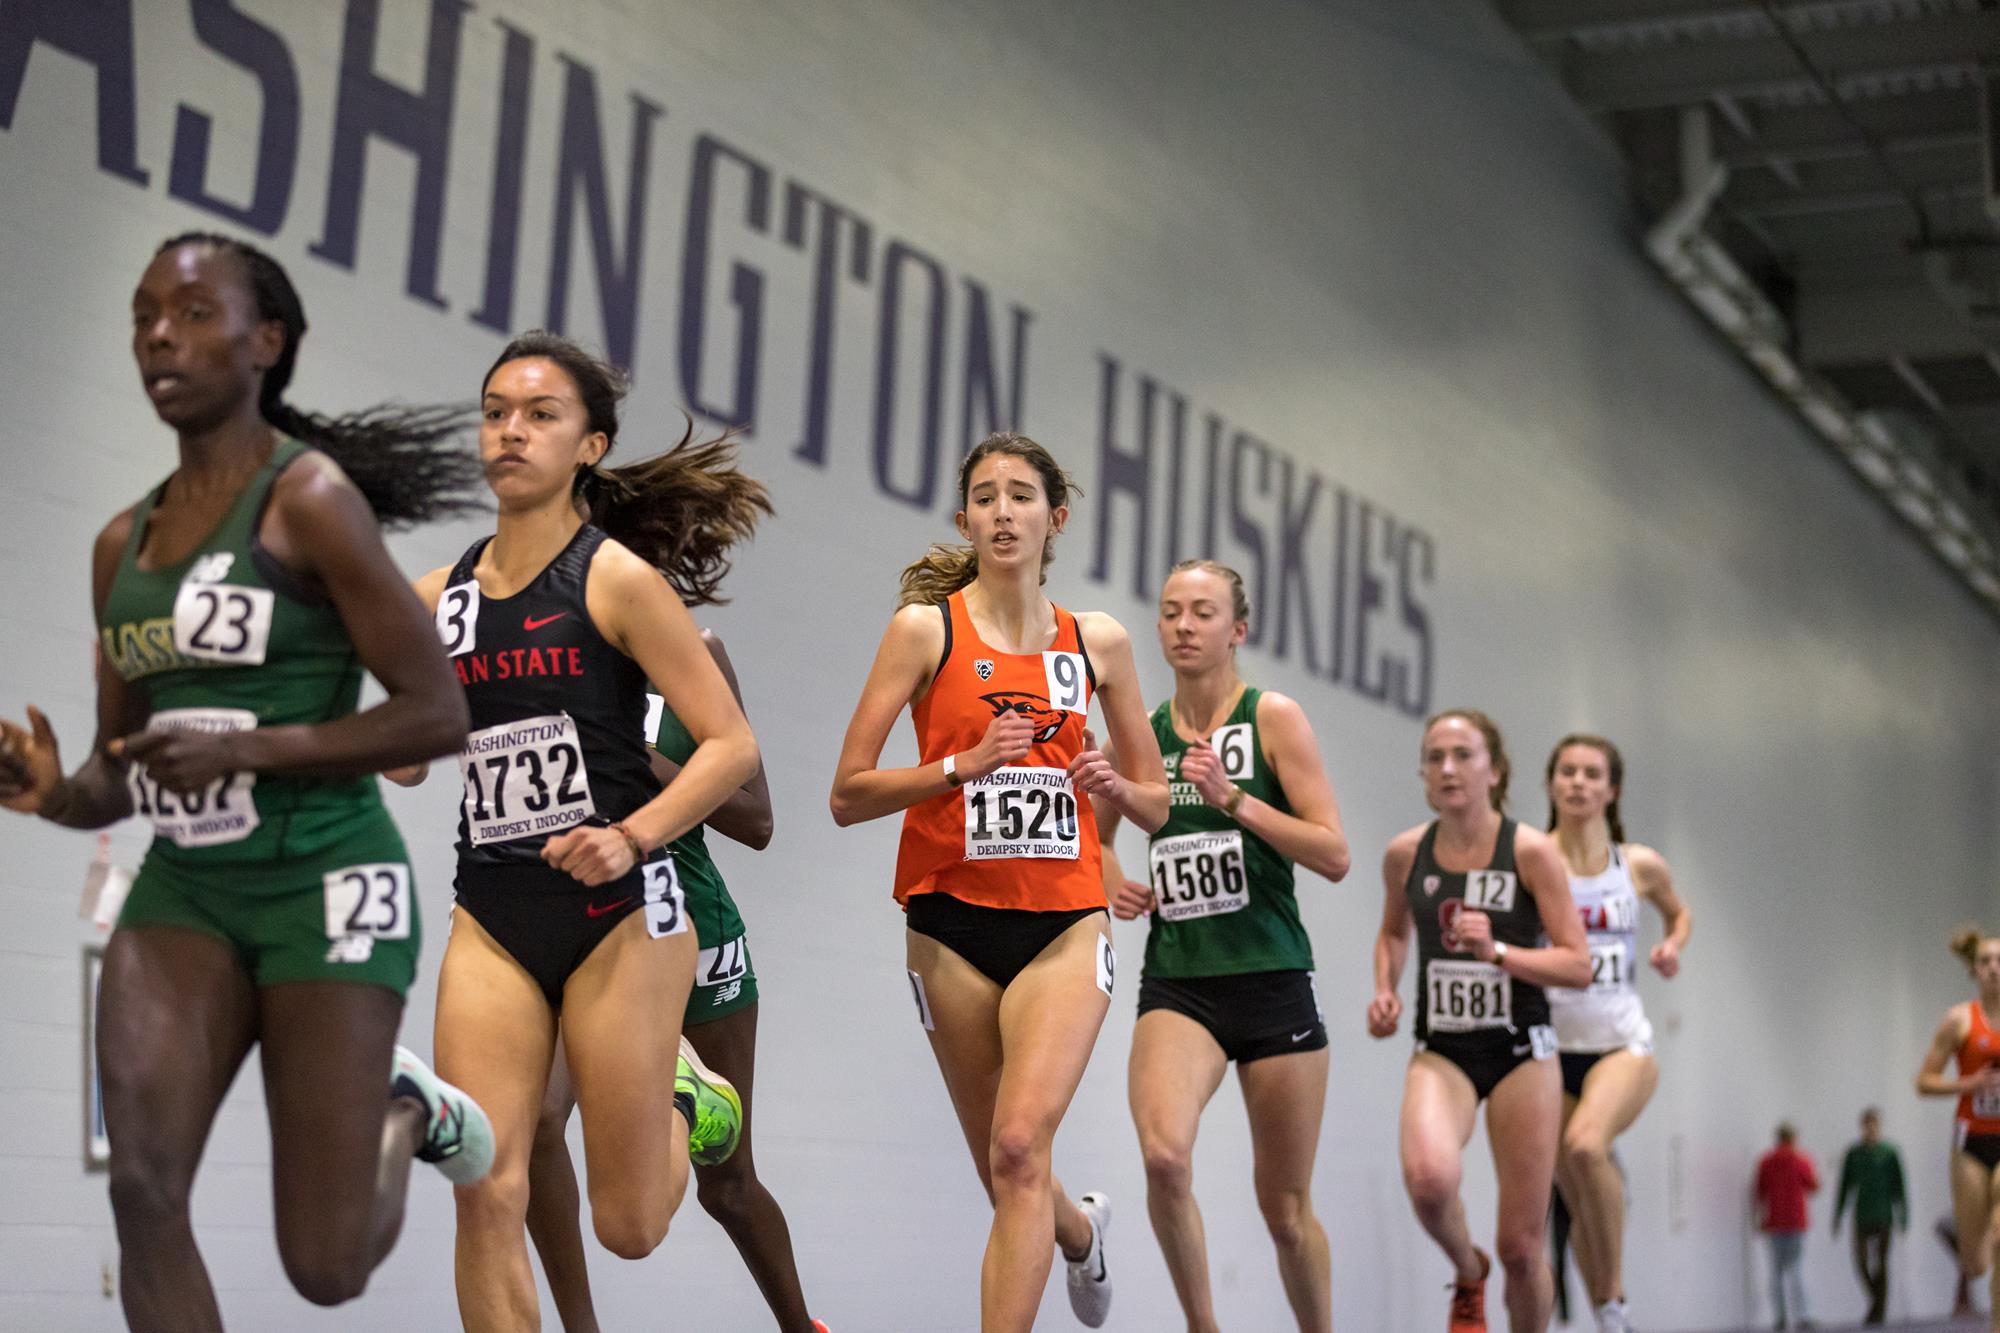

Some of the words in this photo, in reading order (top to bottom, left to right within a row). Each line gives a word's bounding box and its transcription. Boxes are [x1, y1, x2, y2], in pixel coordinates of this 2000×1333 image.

[1086, 349, 1435, 718] HUSKIES
[190, 590, 254, 653] 23
[447, 589, 470, 656] 3
[496, 647, 584, 680] STATE
[1053, 654, 1079, 707] 9
[462, 722, 566, 757] WASHINGTON
[1221, 728, 1244, 776] 6
[467, 742, 588, 822] 1732
[480, 819, 532, 840] DEMPSEY
[535, 807, 587, 830] INDOOR
[970, 788, 1077, 842] 1520
[977, 844, 1031, 856] DEMPSEY
[1033, 844, 1074, 855] INDOOR
[342, 870, 398, 931] 23
[655, 865, 678, 933] 3
[1156, 849, 1243, 905] 1586
[1477, 874, 1506, 907] 12
[1433, 980, 1506, 1019] 1681
